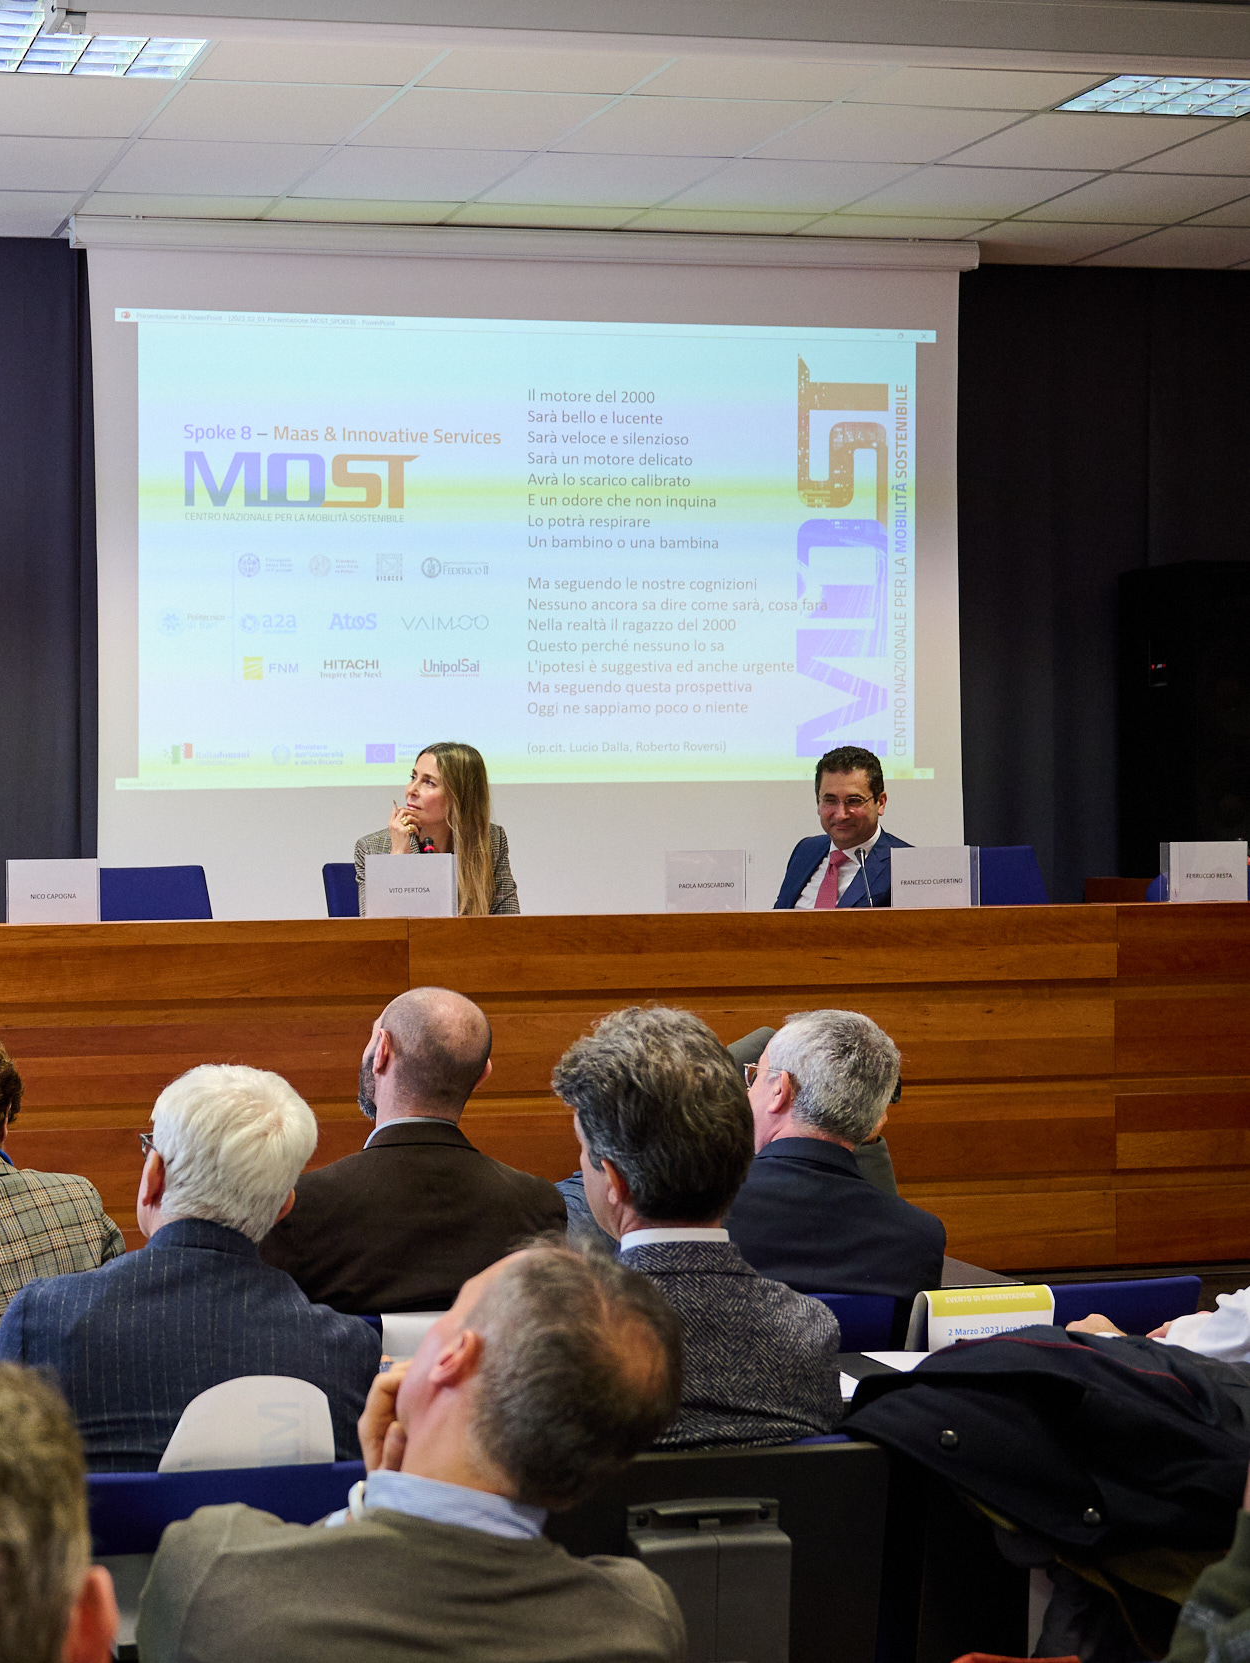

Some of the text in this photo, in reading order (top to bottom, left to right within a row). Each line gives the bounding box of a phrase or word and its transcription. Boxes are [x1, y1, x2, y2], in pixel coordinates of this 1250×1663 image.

[528, 388, 655, 404] Il motore del 2000
[528, 410, 663, 425] Sarà bello e lucente
[183, 423, 236, 444] Spoke
[240, 425, 252, 441] 8
[274, 425, 319, 442] Maas
[342, 427, 429, 443] Innovative
[433, 428, 501, 445] Services
[528, 430, 689, 446] Sarà veloce e silenzioso
[895, 384, 908, 479] SOSTENIBILE
[528, 451, 693, 466] Sarà un motore delicato
[184, 451, 420, 509] MOST
[527, 472, 691, 487] Avrà lo scarico calibrato
[528, 493, 716, 510] E un odore che non inquina
[184, 512, 221, 521] CENTRO
[223, 512, 272, 521] NAZIONALE
[275, 513, 292, 522] PER
[294, 513, 305, 522] LA
[350, 514, 404, 523] SOSTENIBILE
[528, 514, 651, 530] Lo potrà respirare
[528, 535, 719, 549] Un bambino o una bambina
[894, 557, 907, 576] LA
[528, 576, 757, 593] Ma seguendo le nostre cognizioni
[894, 579, 907, 608] PER
[528, 597, 828, 613] Nessuno ancora sa dire come sarà, cosa farà
[262, 614, 297, 628] a2a
[528, 618, 736, 634] Nella realtà il ragazzo del 2000
[527, 639, 724, 655] Questo perché nessuno lo sa
[894, 611, 907, 694] NAZIONALE
[268, 663, 299, 673] FNM
[324, 659, 379, 669] HITACHI
[423, 658, 480, 676] UnipolSai
[528, 659, 794, 676] L'ipotesi è suggestiva ed anche urgente
[320, 671, 347, 679] Inspire
[528, 680, 752, 698] Ma seguendo questa prospettiva
[527, 701, 748, 717] Oggi ne sappiamo poco o niente
[894, 697, 907, 757] CENTRO
[527, 740, 727, 755] (op.cit. Lucio Dalla, Roberto Roversi)
[678, 882, 697, 890] PAOLA
[900, 878, 931, 886] FRANCESCO
[30, 892, 77, 901] NICO CAPOGNA
[945, 1296, 972, 1304] EVENTO
[982, 1292, 1036, 1301] PRESENTAZIONE
[955, 1327, 978, 1336] Marzo
[980, 1326, 999, 1334] 2023
